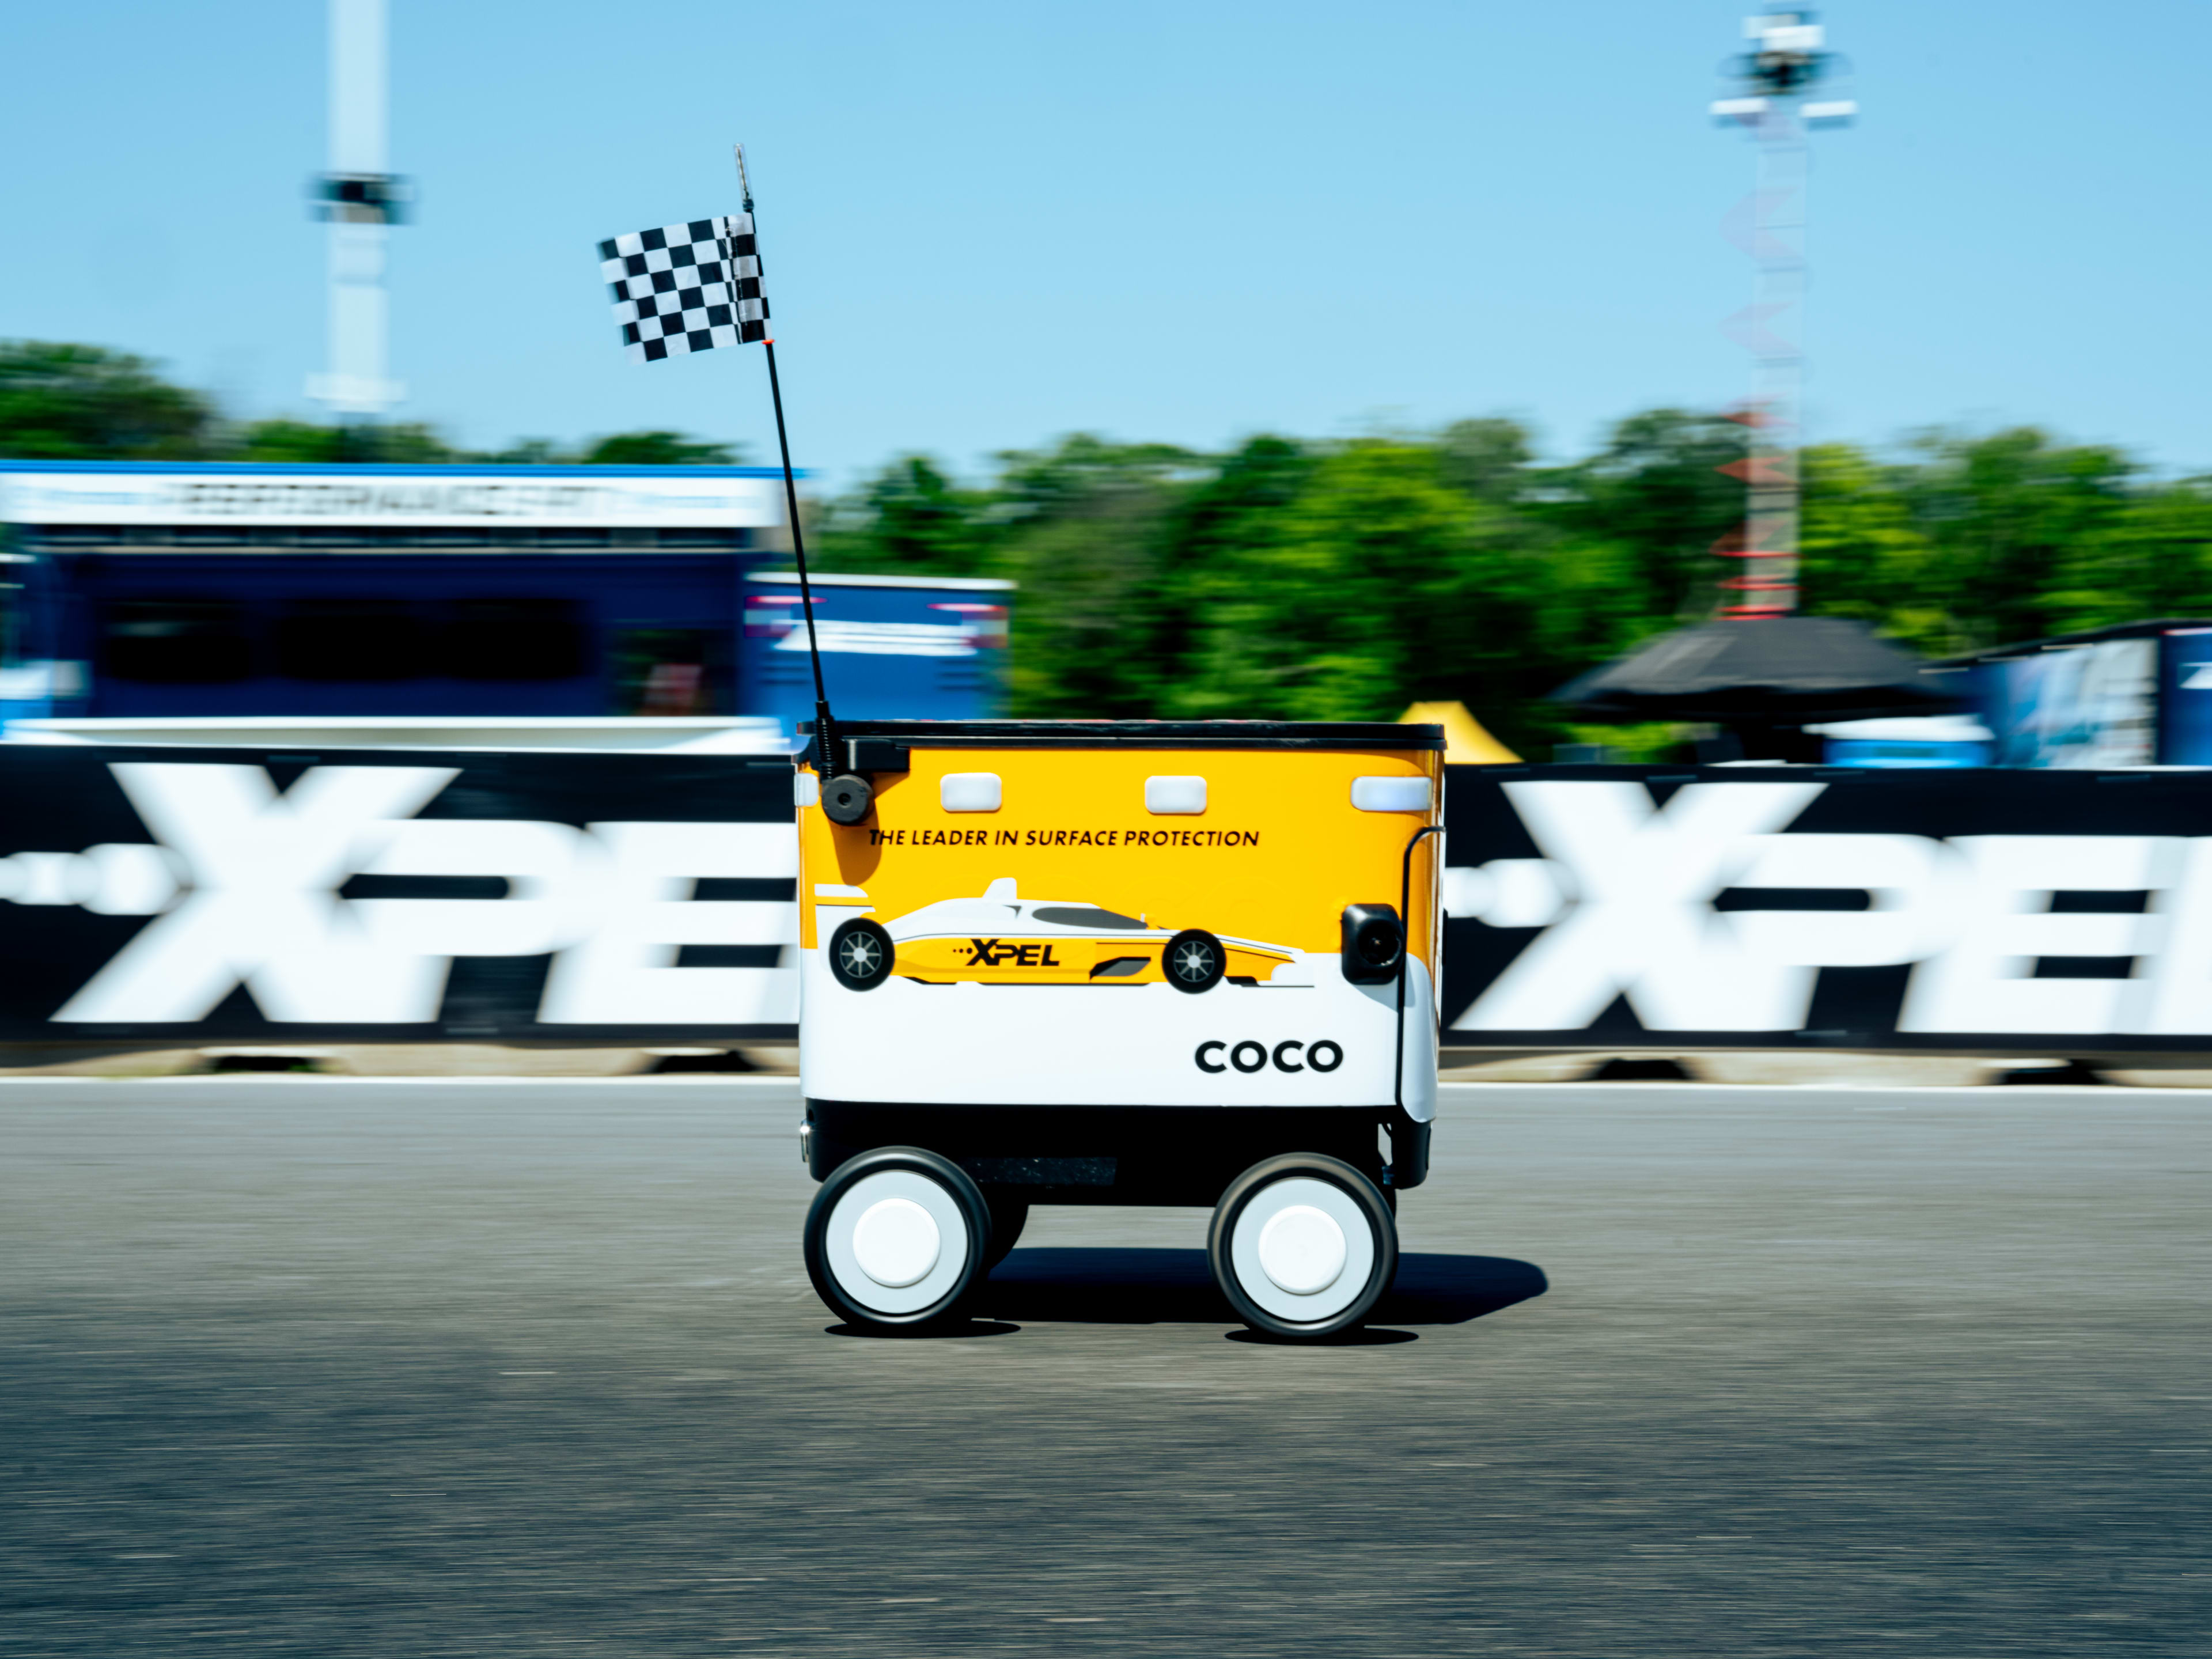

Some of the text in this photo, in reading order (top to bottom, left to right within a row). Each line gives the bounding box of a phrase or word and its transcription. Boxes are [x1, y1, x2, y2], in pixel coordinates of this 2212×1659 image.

[869, 830, 1259, 846] THE LEADER IN SURFACE PROTECTION
[49, 762, 798, 1024] XPE
[966, 939, 1060, 966] XPEL
